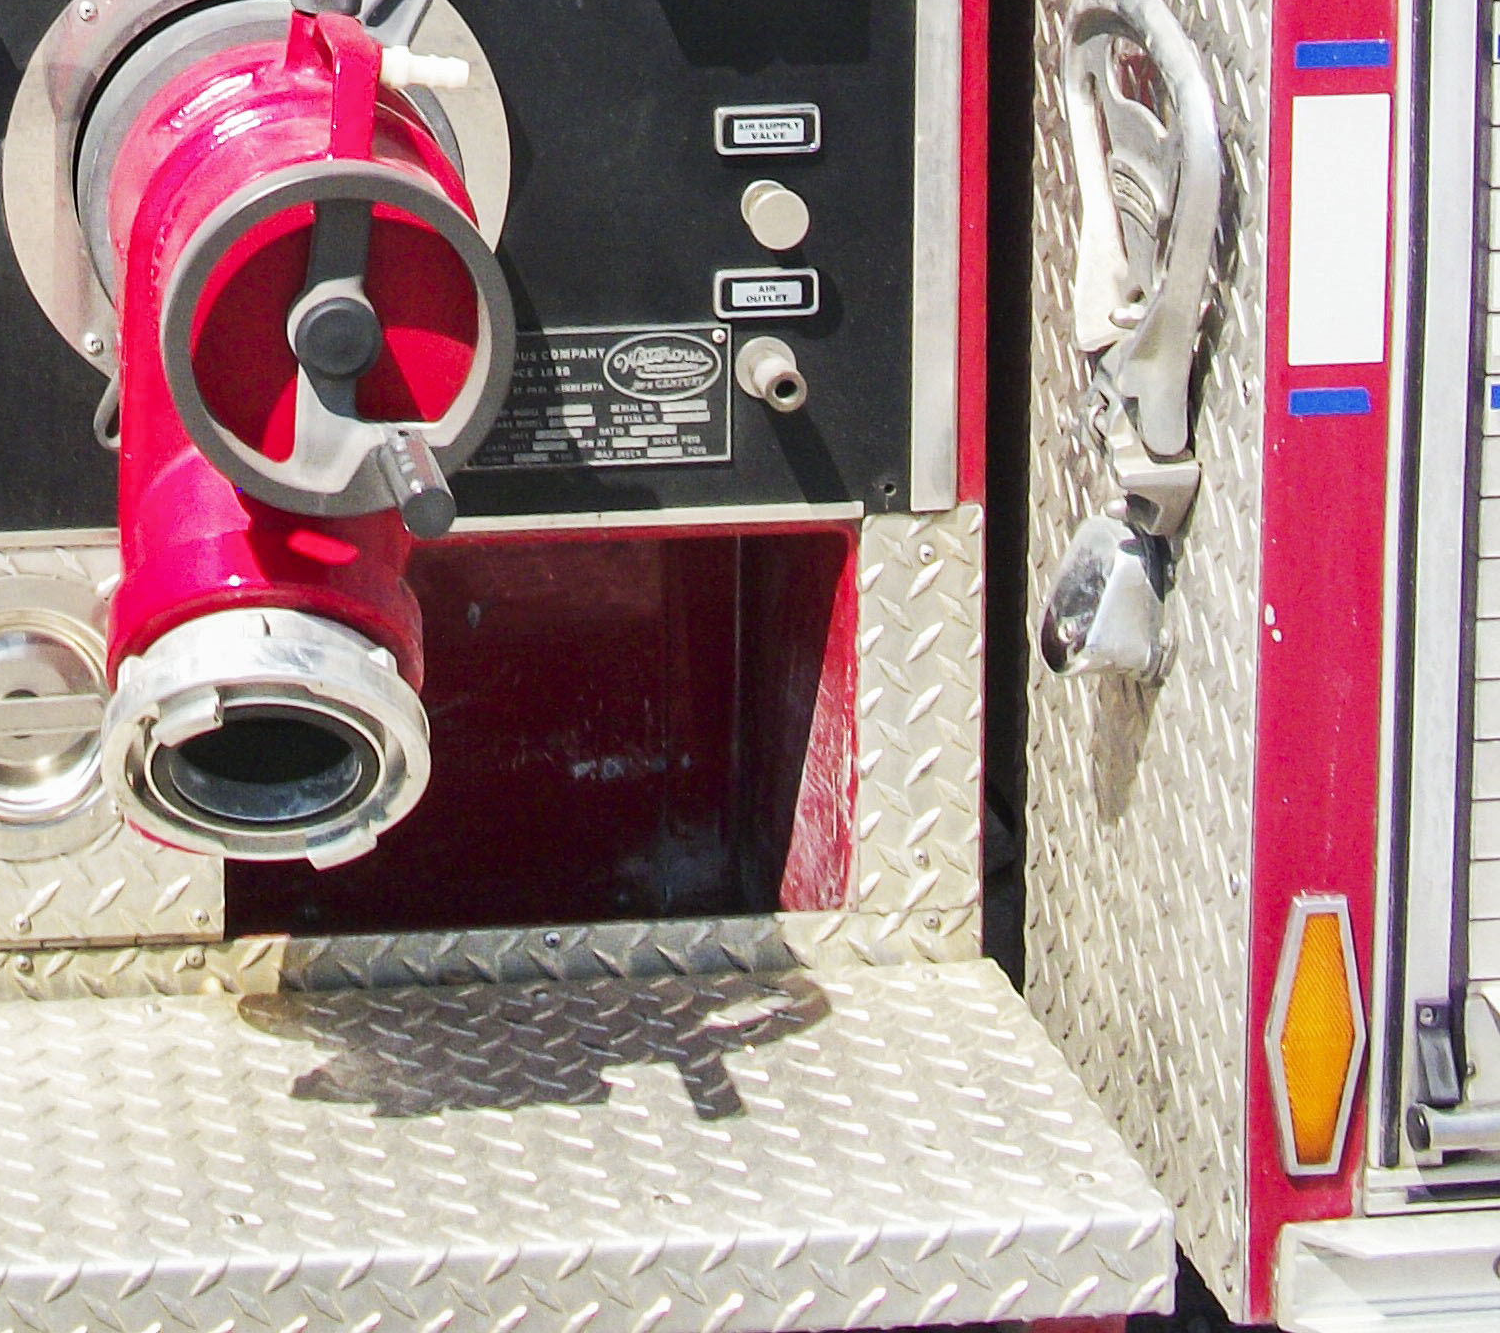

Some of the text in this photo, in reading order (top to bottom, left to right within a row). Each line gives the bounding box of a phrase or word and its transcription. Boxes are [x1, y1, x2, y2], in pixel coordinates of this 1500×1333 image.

[737, 122, 800, 130] AIR SUPPLY
[750, 132, 786, 140] VALVE
[758, 285, 777, 293] AIR
[746, 294, 788, 303] OUTLET
[541, 348, 607, 361] COMPANY
